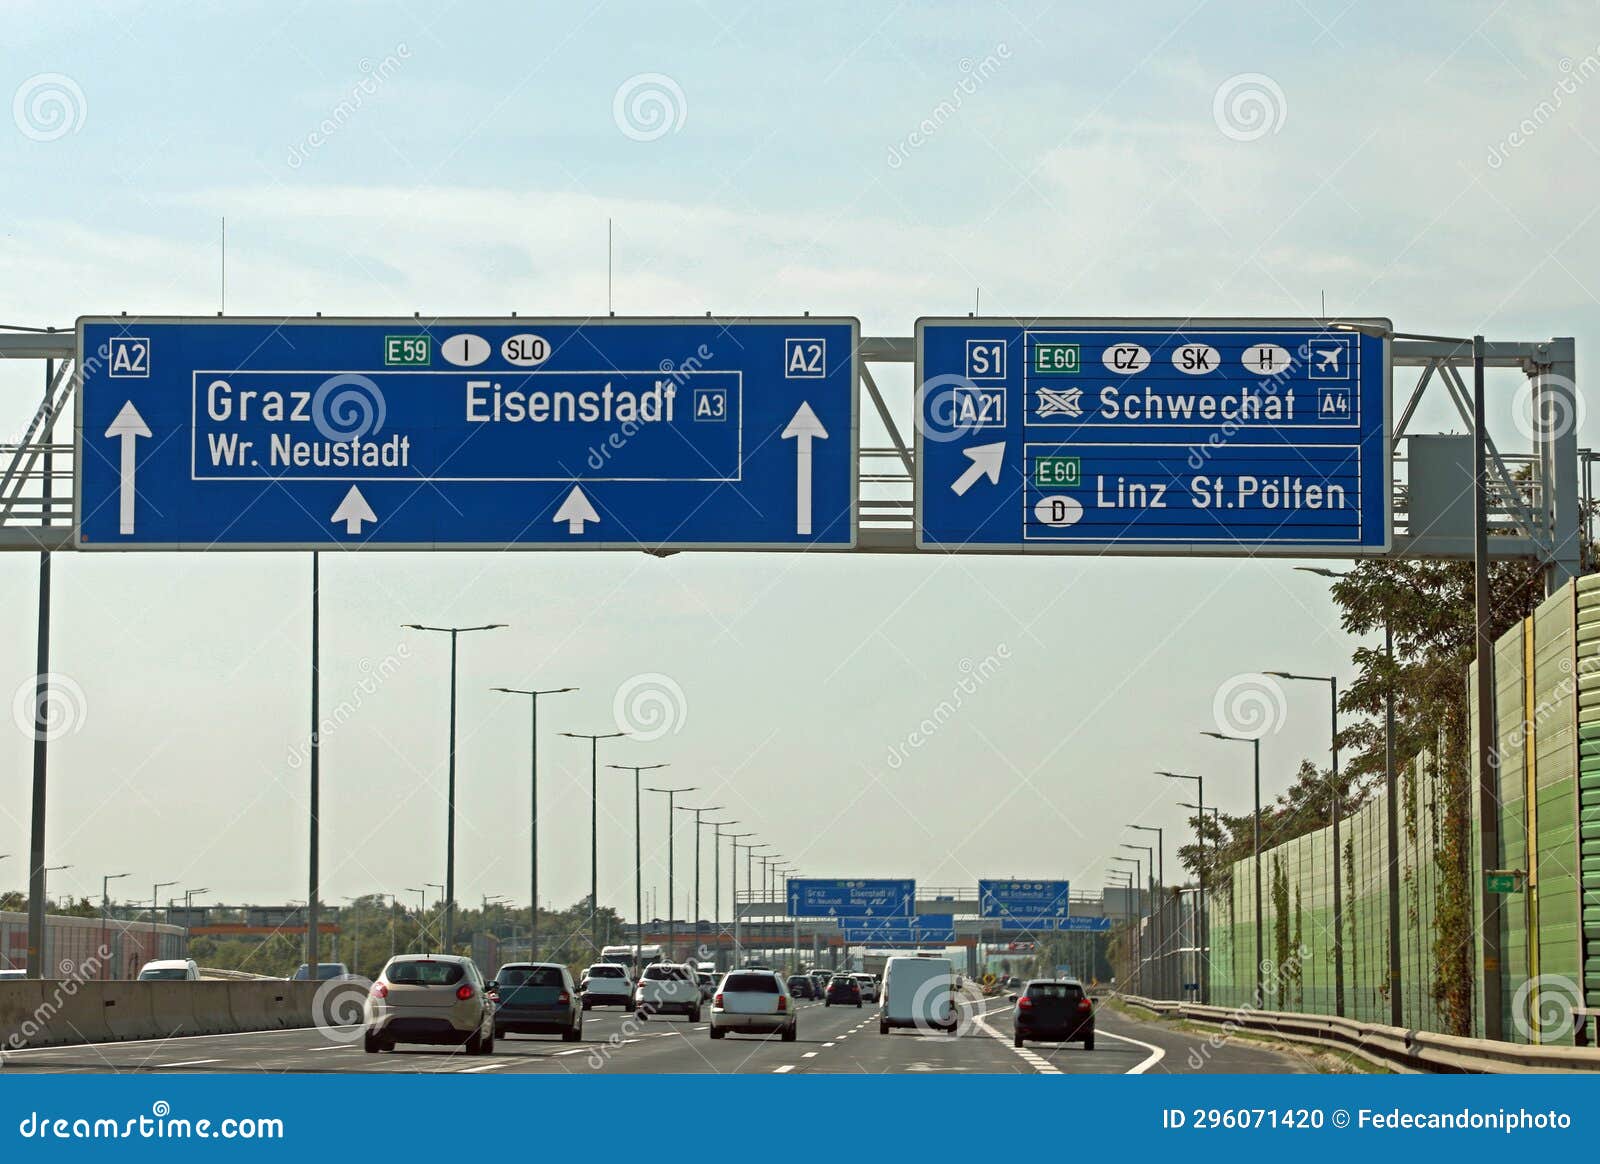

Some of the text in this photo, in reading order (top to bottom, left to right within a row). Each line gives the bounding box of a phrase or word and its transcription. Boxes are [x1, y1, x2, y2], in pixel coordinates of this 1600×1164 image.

[113, 344, 146, 371] A2
[389, 340, 426, 361] E59
[506, 339, 545, 361] SLO
[789, 344, 822, 372] A2
[972, 346, 1001, 373] S1
[1039, 347, 1273, 370] E60 CZ SK H
[208, 380, 725, 422] Graz Eisenstadt A3
[958, 392, 1002, 422] A21
[1100, 387, 1348, 420] Schwechat A4
[208, 433, 410, 467] Wr. Neustadt
[1040, 462, 1077, 482] E60
[1096, 475, 1345, 509] Linz St.Pölten
[1051, 501, 1066, 522] D
